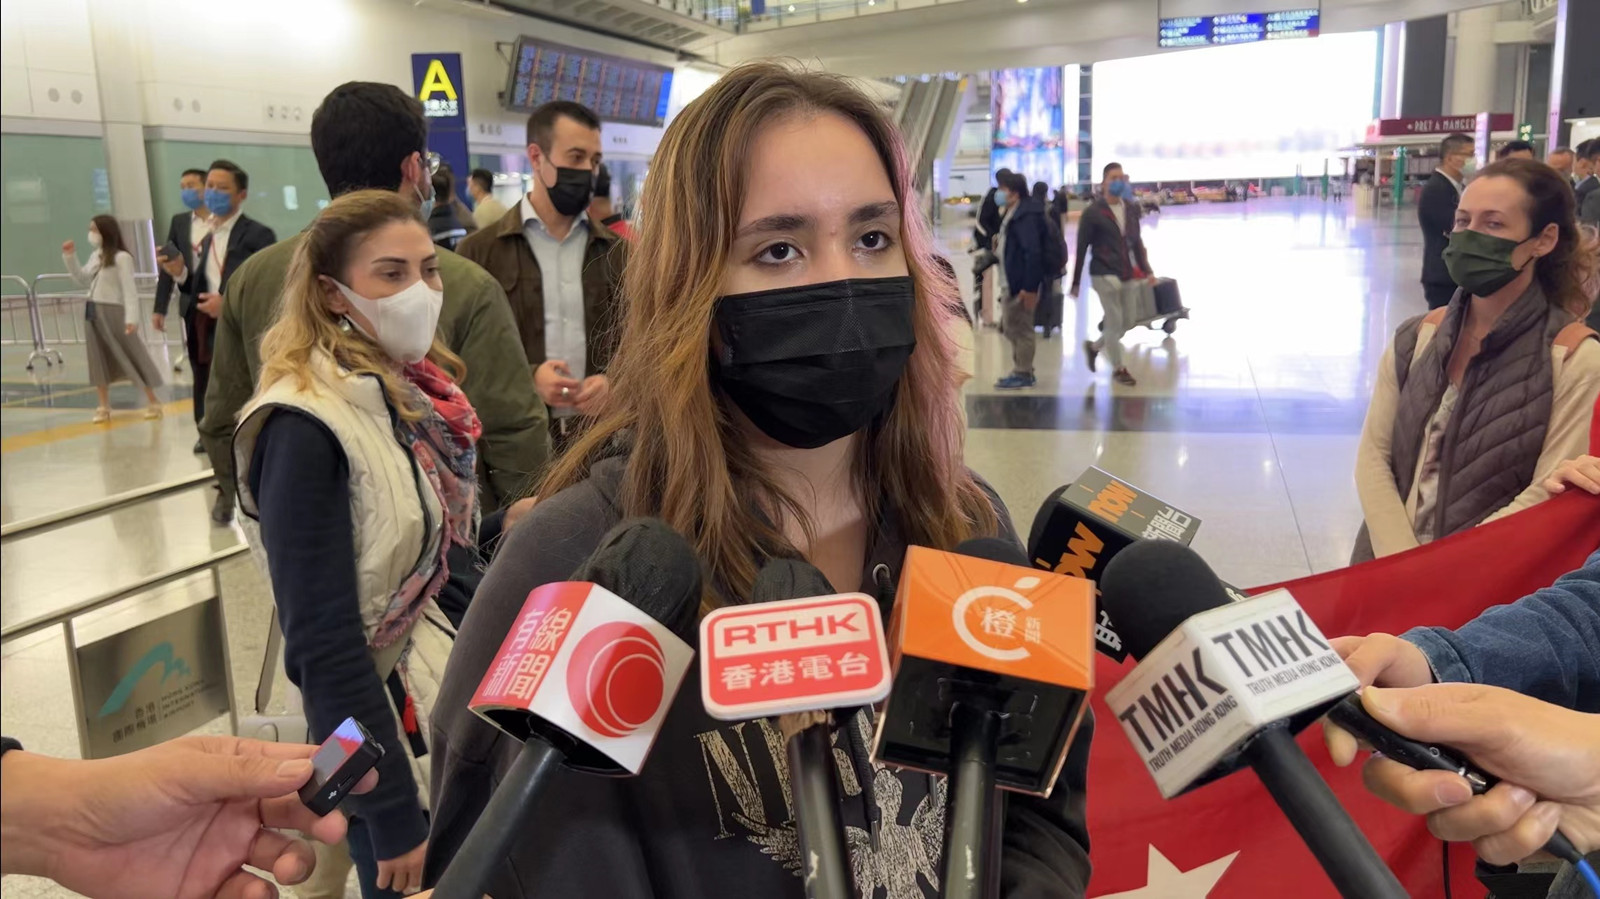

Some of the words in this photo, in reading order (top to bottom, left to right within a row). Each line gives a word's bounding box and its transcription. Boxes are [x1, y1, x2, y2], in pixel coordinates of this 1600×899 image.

[419, 59, 458, 101] A
[1414, 119, 1433, 132] PRET
[1434, 120, 1441, 131] A
[1442, 118, 1476, 131] MANGER
[509, 606, 572, 651] 有線
[723, 612, 860, 647] RTHK
[1212, 609, 1330, 678] TMHK
[482, 653, 551, 699] 新聞
[721, 652, 870, 691] 香港電台
[1246, 678, 1275, 697] TRUTH
[1272, 668, 1300, 688] MEDIA
[1298, 661, 1321, 680] HONG
[1320, 653, 1342, 671] KONG
[1119, 646, 1228, 753] TMHK
[1149, 746, 1172, 773] TRUTH
[1170, 728, 1195, 758] MEDIA
[1192, 710, 1217, 741] HONG
[1214, 694, 1239, 724] KONG
